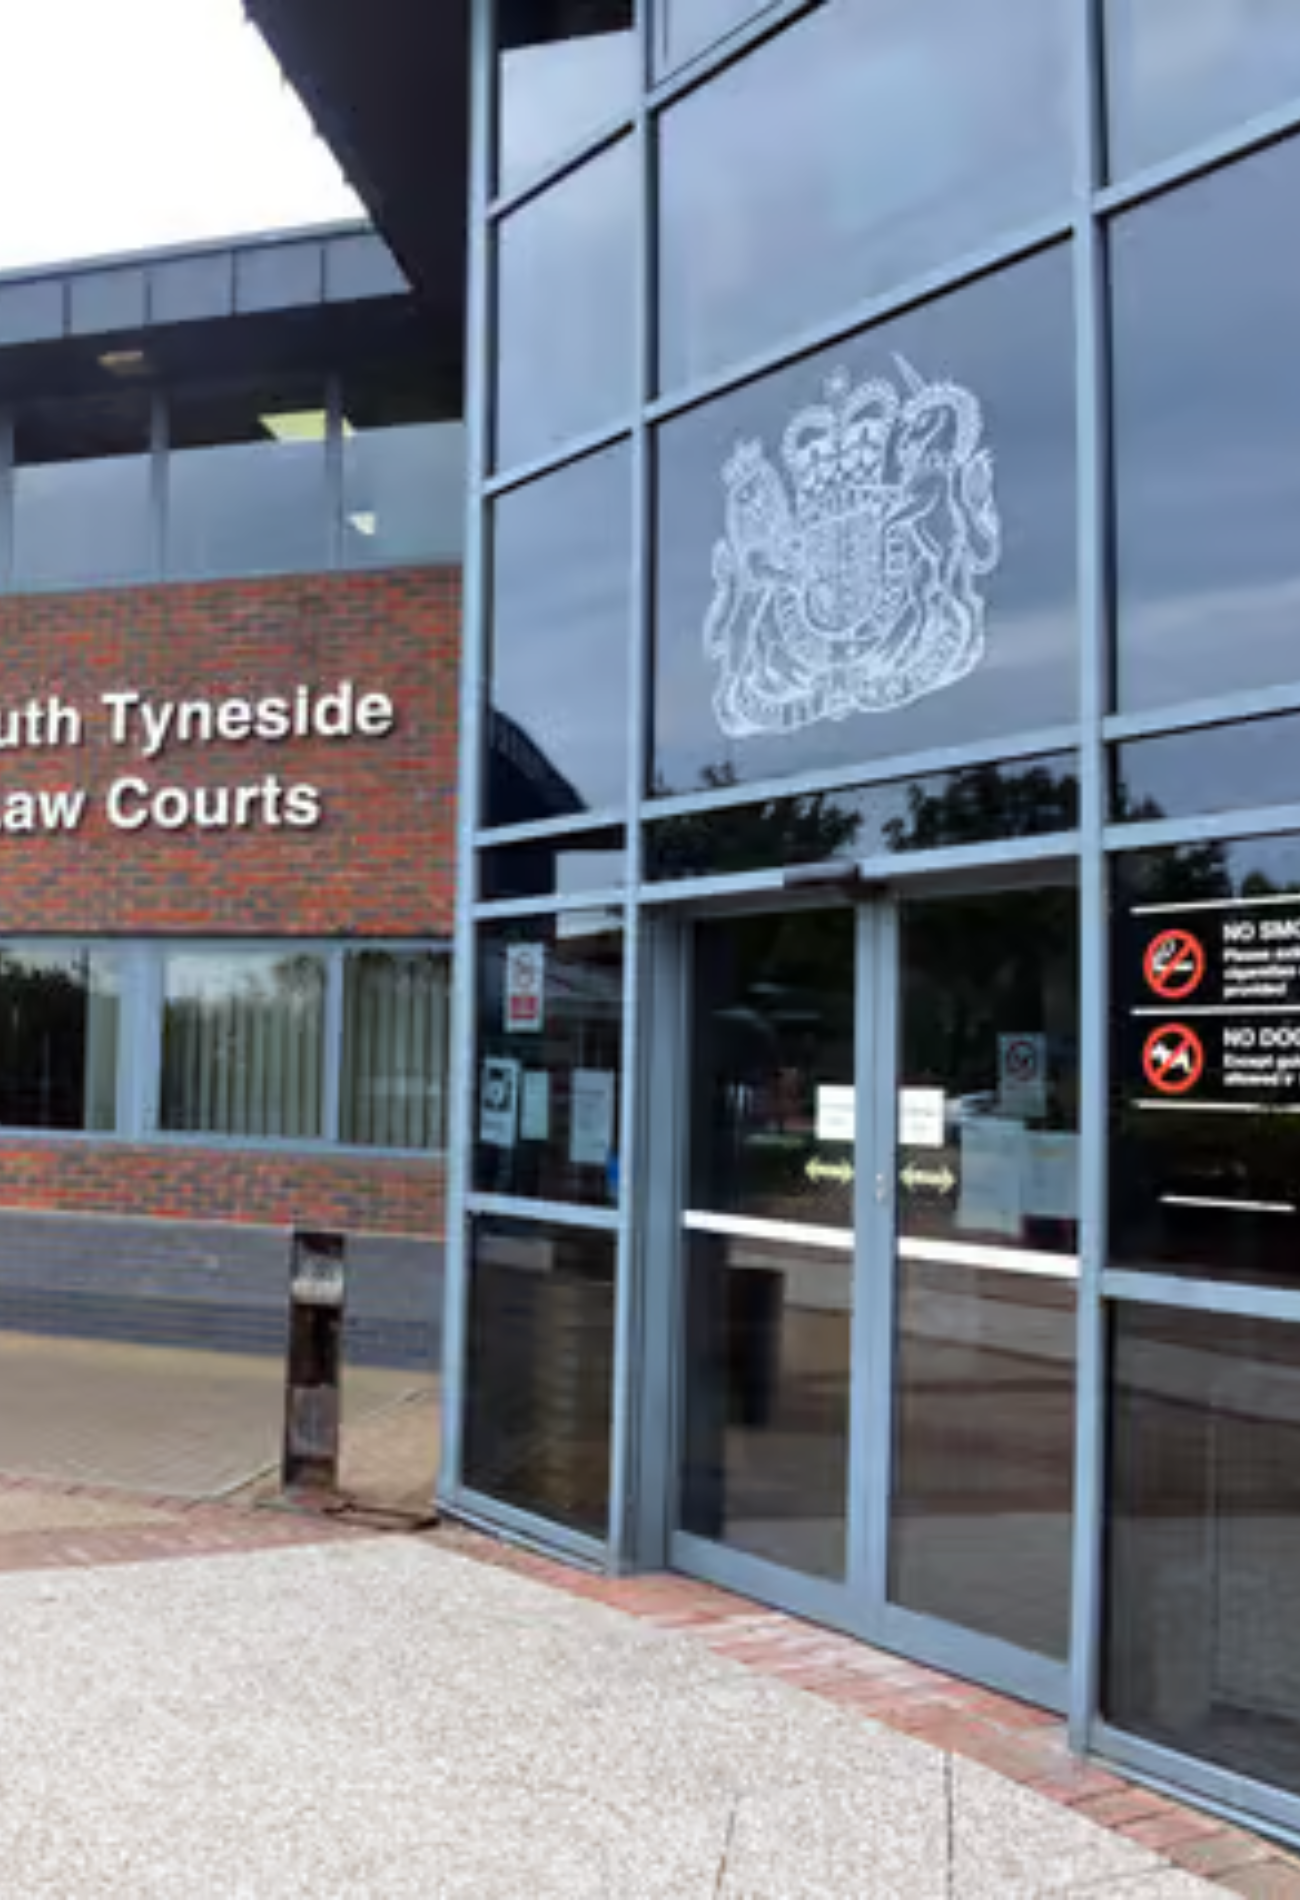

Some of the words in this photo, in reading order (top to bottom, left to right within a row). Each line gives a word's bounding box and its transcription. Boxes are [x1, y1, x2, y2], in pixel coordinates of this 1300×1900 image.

[101, 680, 393, 756] Tyneside
[106, 775, 320, 830] Courts
[1222, 921, 1256, 943] NO
[1222, 1026, 1256, 1047] NO
